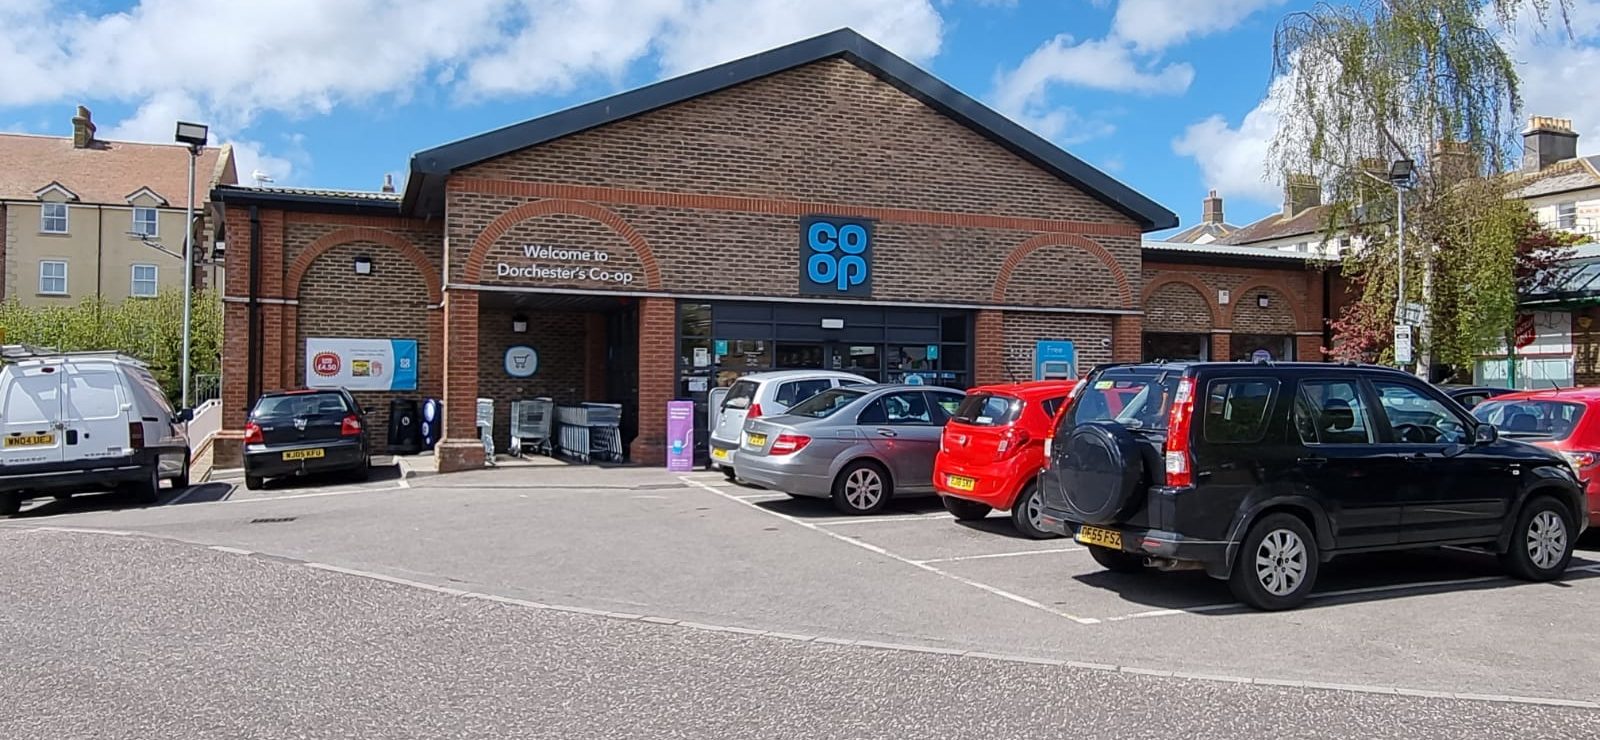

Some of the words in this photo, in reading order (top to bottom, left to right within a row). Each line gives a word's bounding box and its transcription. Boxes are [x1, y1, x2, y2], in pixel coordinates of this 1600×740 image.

[523, 245, 591, 261] Welcome
[594, 250, 608, 262] to
[497, 263, 586, 280] Dorchester’s
[589, 268, 633, 284] Co-op
[1047, 345, 1063, 354] Free
[1104, 530, 1121, 546] FSZ
